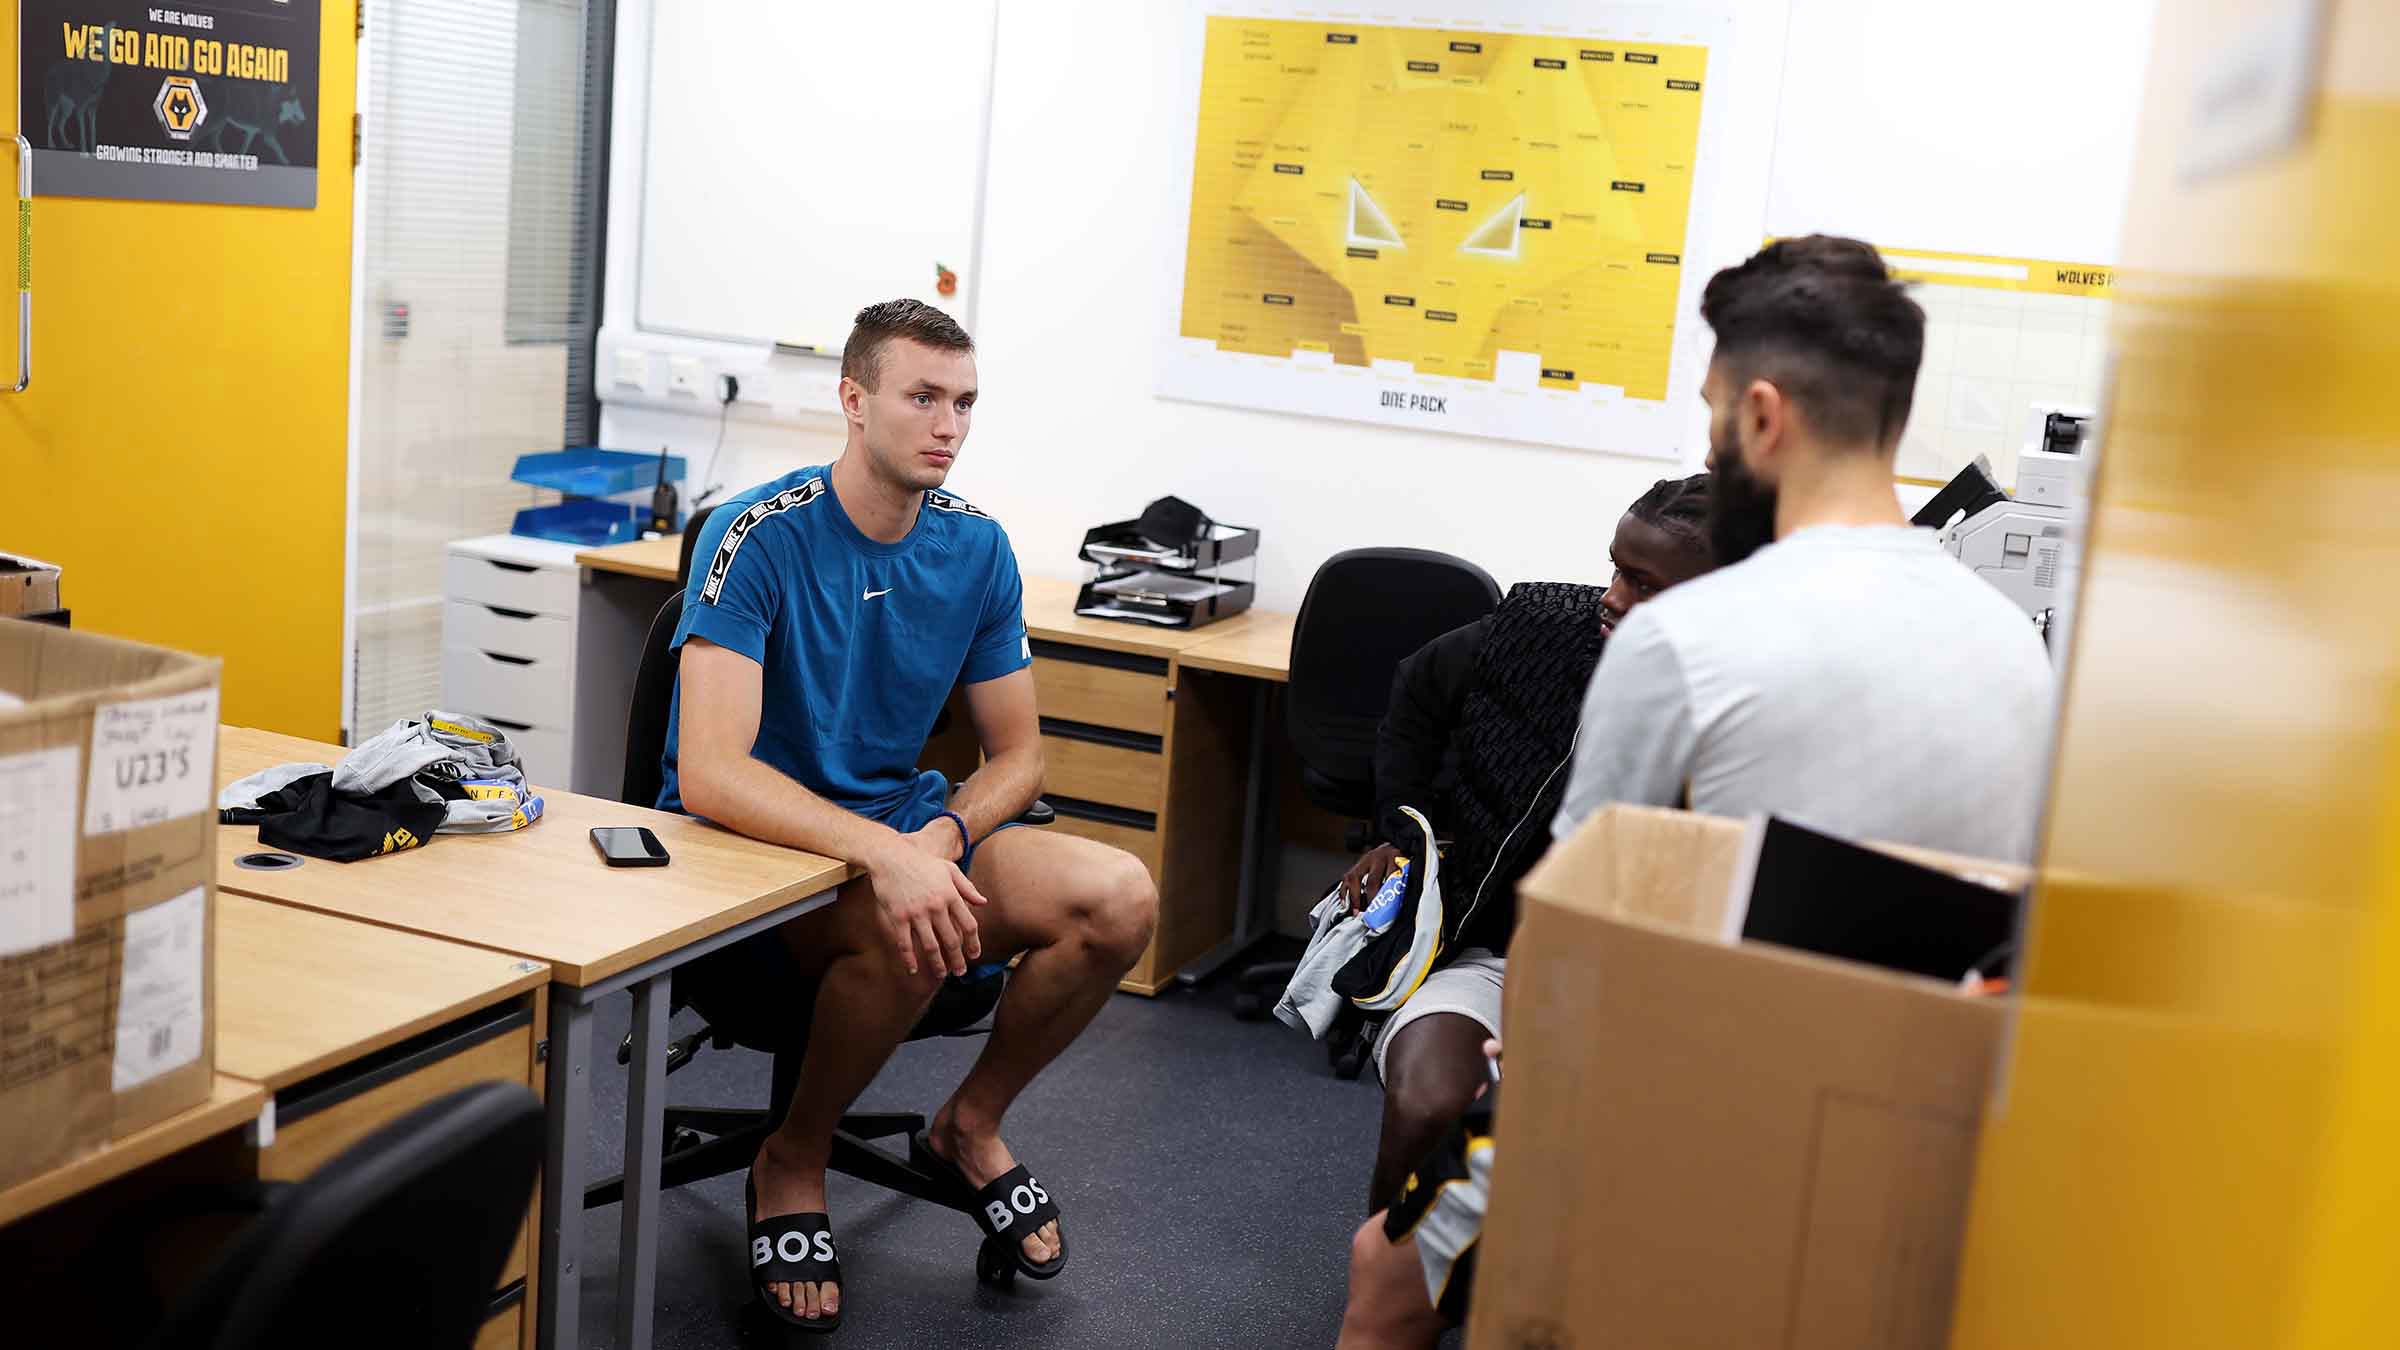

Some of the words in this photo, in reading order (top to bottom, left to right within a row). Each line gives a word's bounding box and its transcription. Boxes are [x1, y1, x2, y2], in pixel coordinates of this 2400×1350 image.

[149, 8, 163, 23] WE
[164, 10, 180, 25] ARE
[181, 12, 214, 30] WOLVES
[63, 22, 105, 62] WE
[109, 27, 140, 65] GO
[144, 32, 190, 71] AND
[193, 38, 222, 76] GO
[226, 43, 289, 83] AGAIN
[96, 145, 142, 163] GROWING
[143, 148, 193, 167] STRONGER
[194, 151, 213, 168] AND
[214, 153, 258, 171] SMARTER
[2056, 269, 2105, 287] WOLVES
[1381, 390, 1407, 409] ONE
[1410, 392, 1448, 415] PACK
[722, 529, 741, 554] NIKE
[705, 573, 720, 599] NIKE
[752, 1230, 840, 1269] BOS
